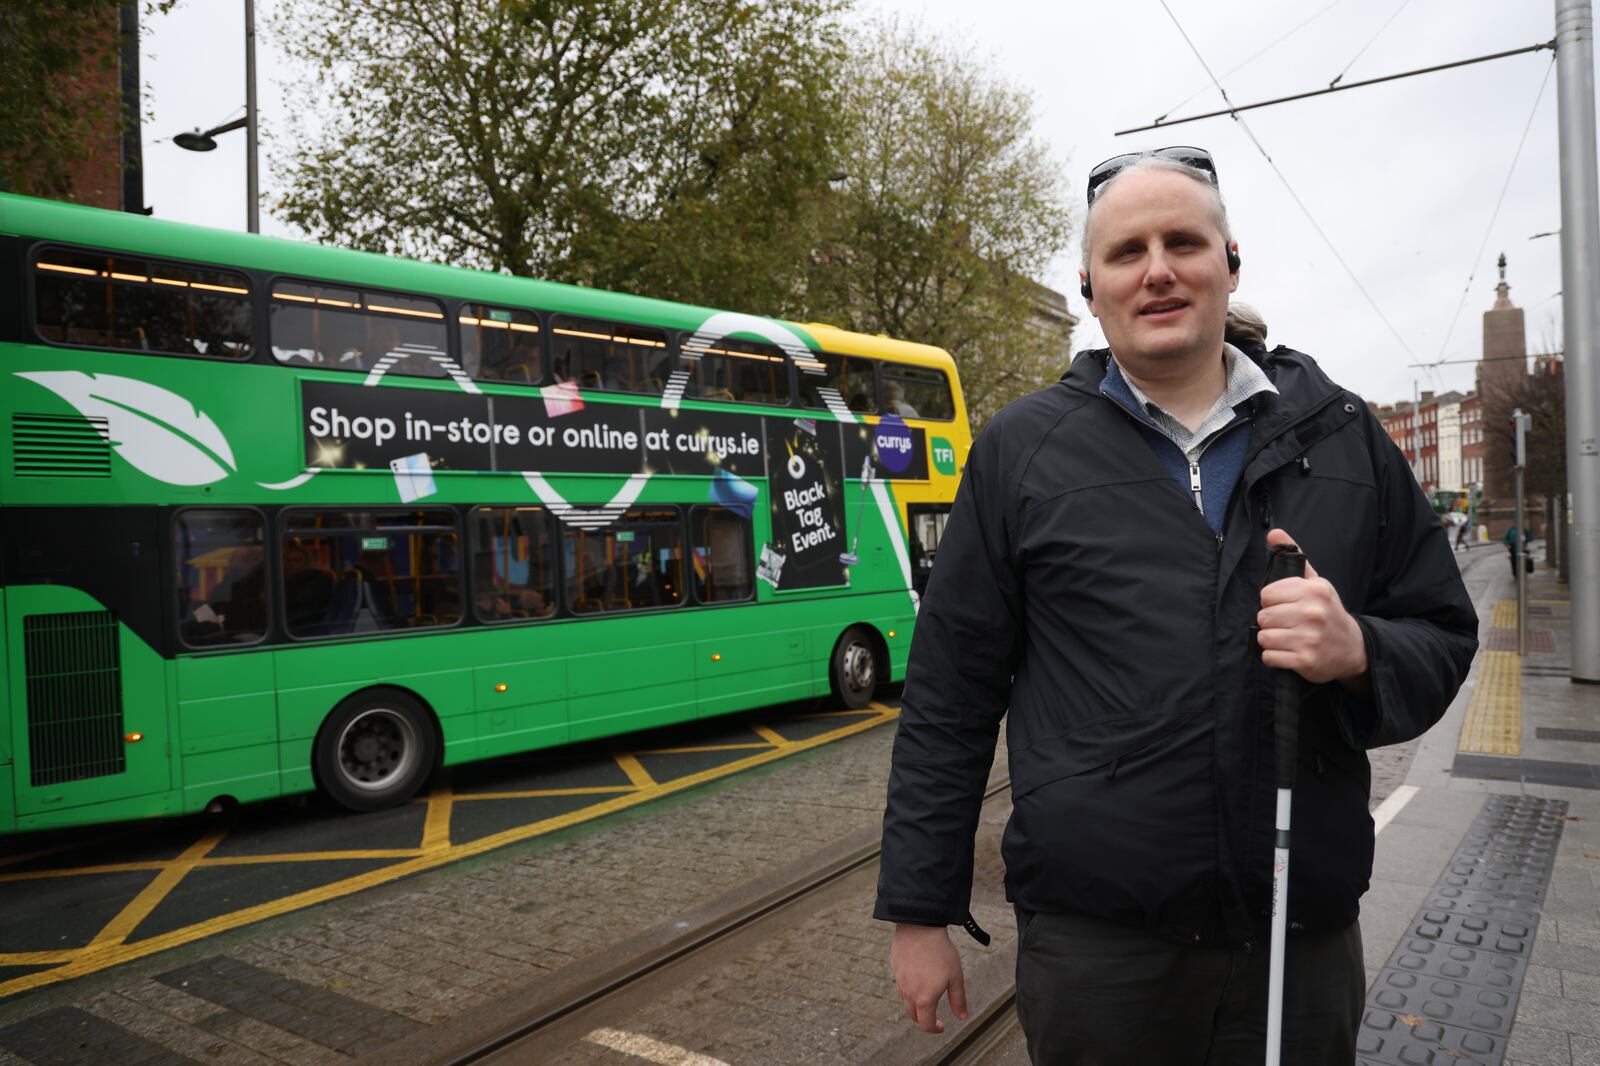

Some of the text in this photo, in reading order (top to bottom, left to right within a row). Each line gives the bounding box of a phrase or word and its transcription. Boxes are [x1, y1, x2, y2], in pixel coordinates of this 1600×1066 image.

[309, 407, 760, 459] Shop in-store or online at currys.ie
[877, 435, 912, 453] currys
[784, 481, 825, 510] Black
[796, 506, 824, 528] Tag
[792, 522, 836, 552] Event.
